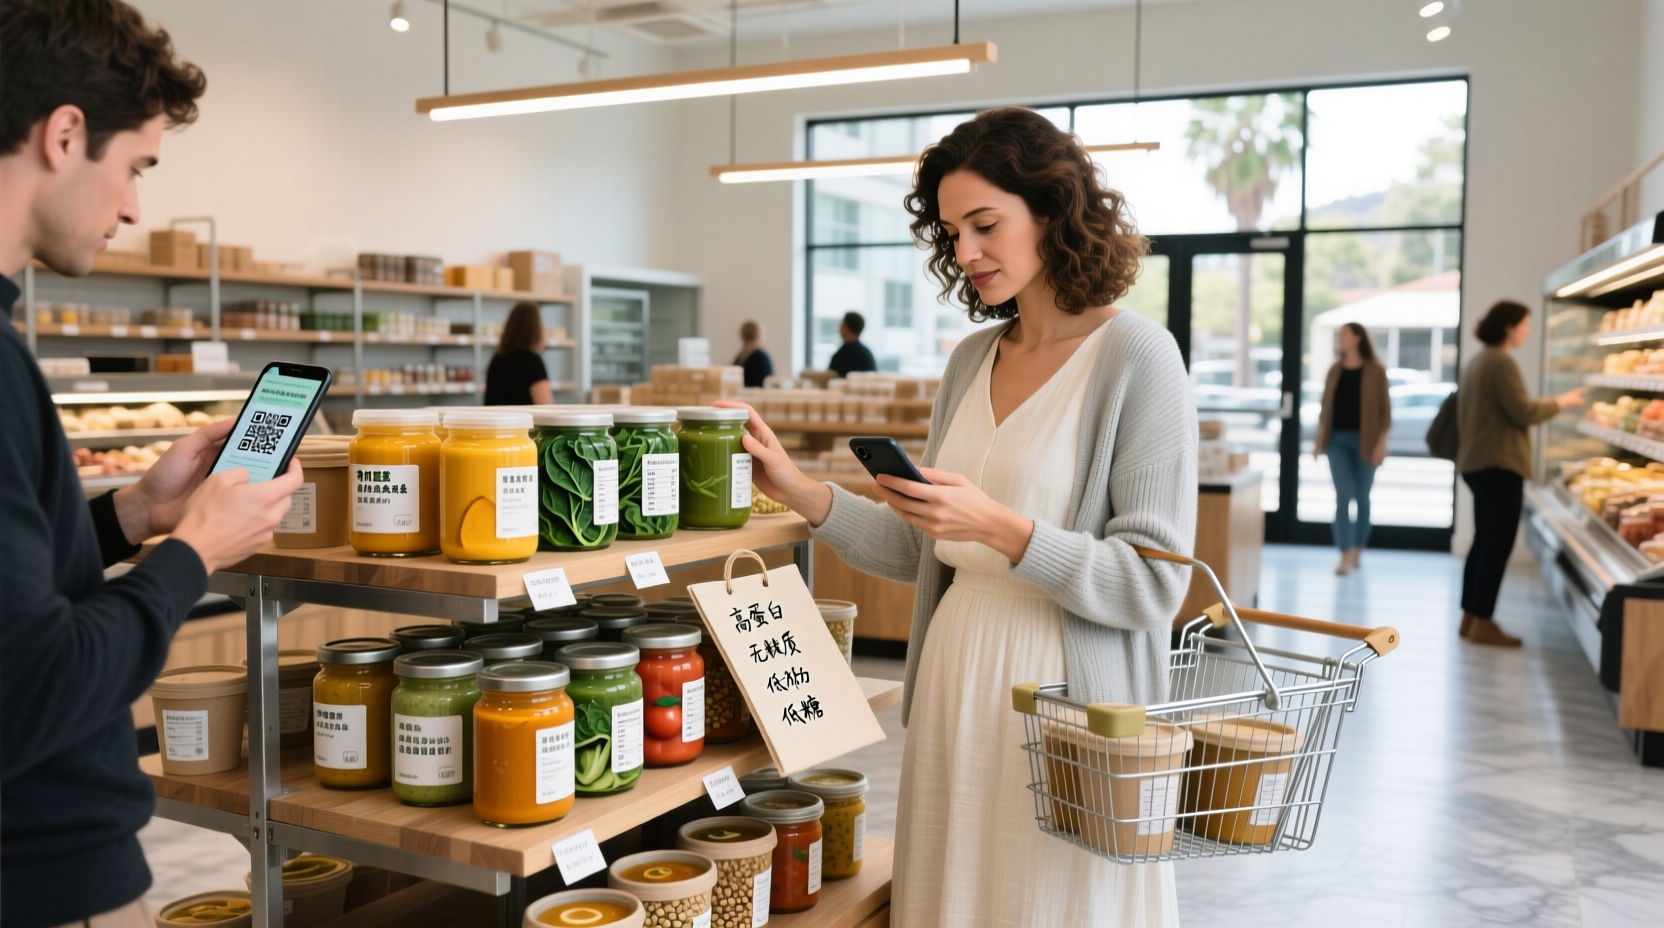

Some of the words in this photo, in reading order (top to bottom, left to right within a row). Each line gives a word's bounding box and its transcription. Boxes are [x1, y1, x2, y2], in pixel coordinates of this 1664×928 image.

[729, 600, 783, 634] 高蛋白
[781, 694, 824, 727] 低糖
